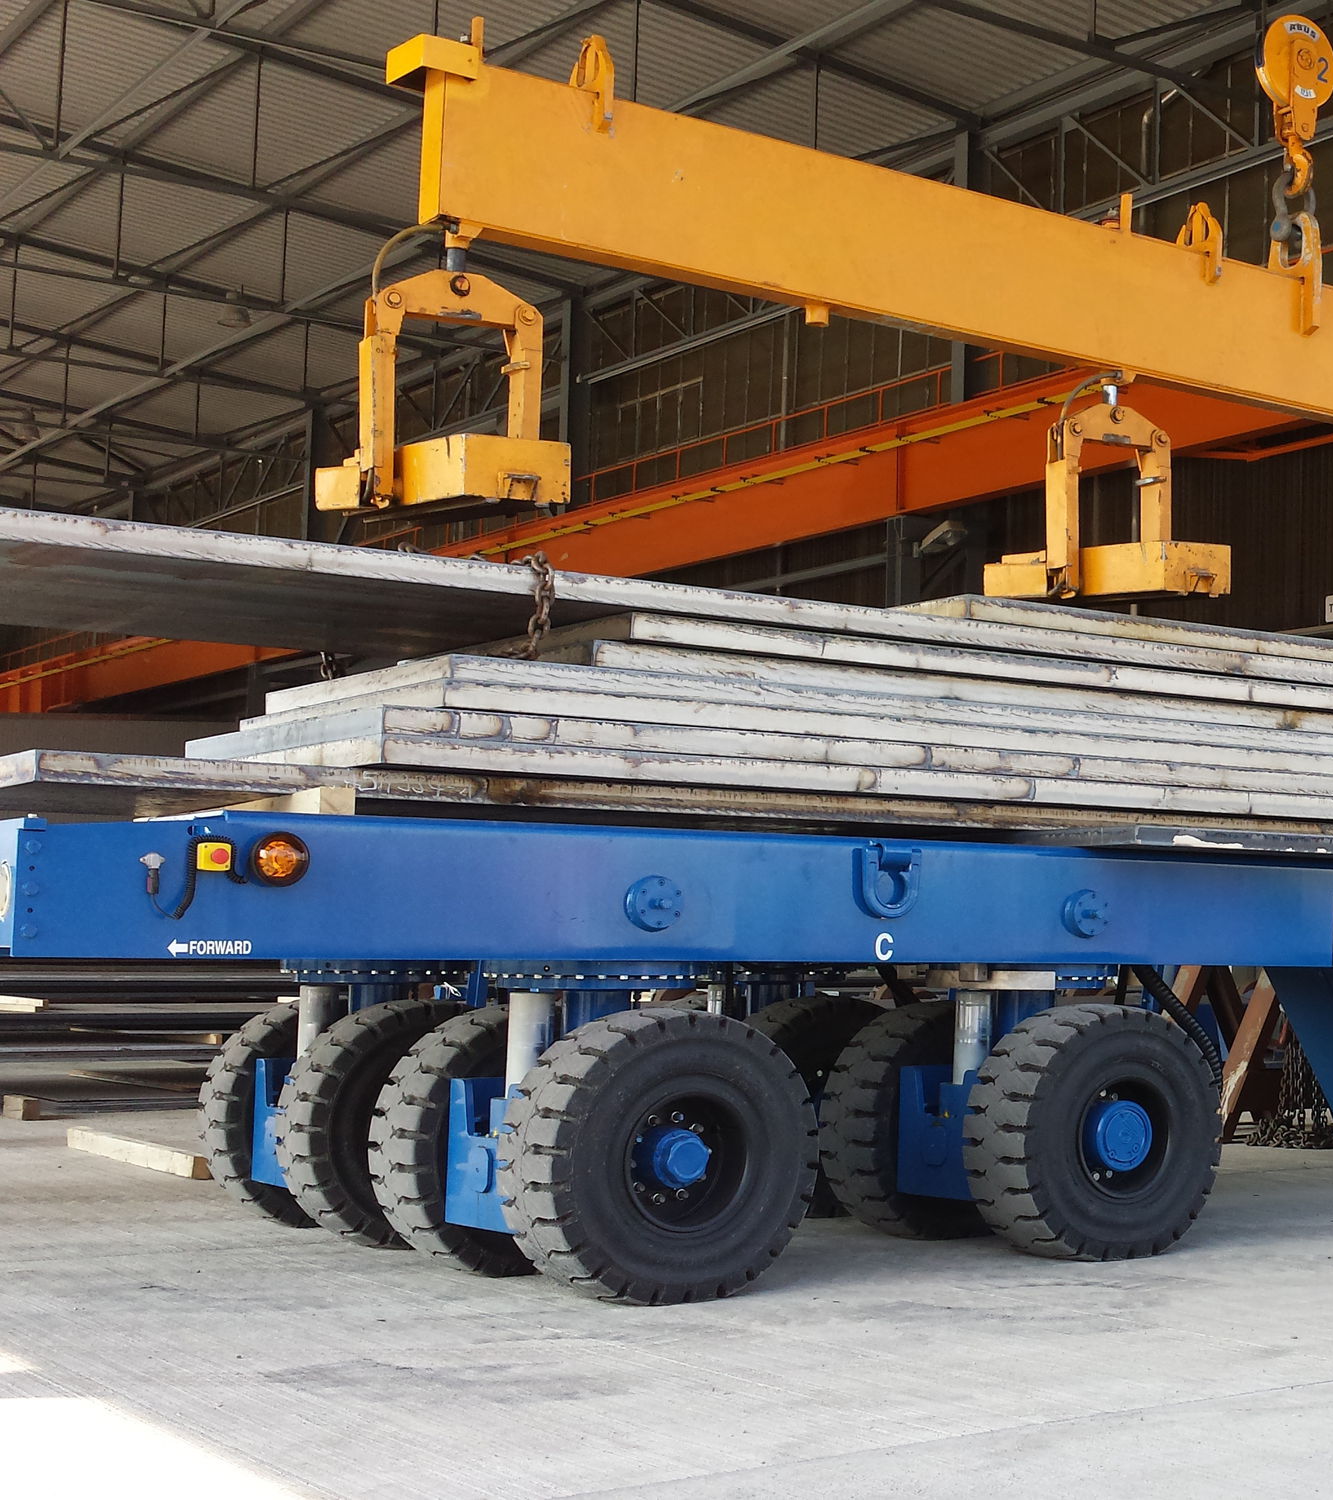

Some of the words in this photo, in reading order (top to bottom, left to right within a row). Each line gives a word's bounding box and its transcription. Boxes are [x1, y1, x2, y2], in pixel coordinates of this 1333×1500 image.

[1289, 23, 1317, 39] ABUS
[1317, 57, 1329, 84] 2
[189, 940, 252, 955] FORWARD
[874, 932, 894, 961] C
